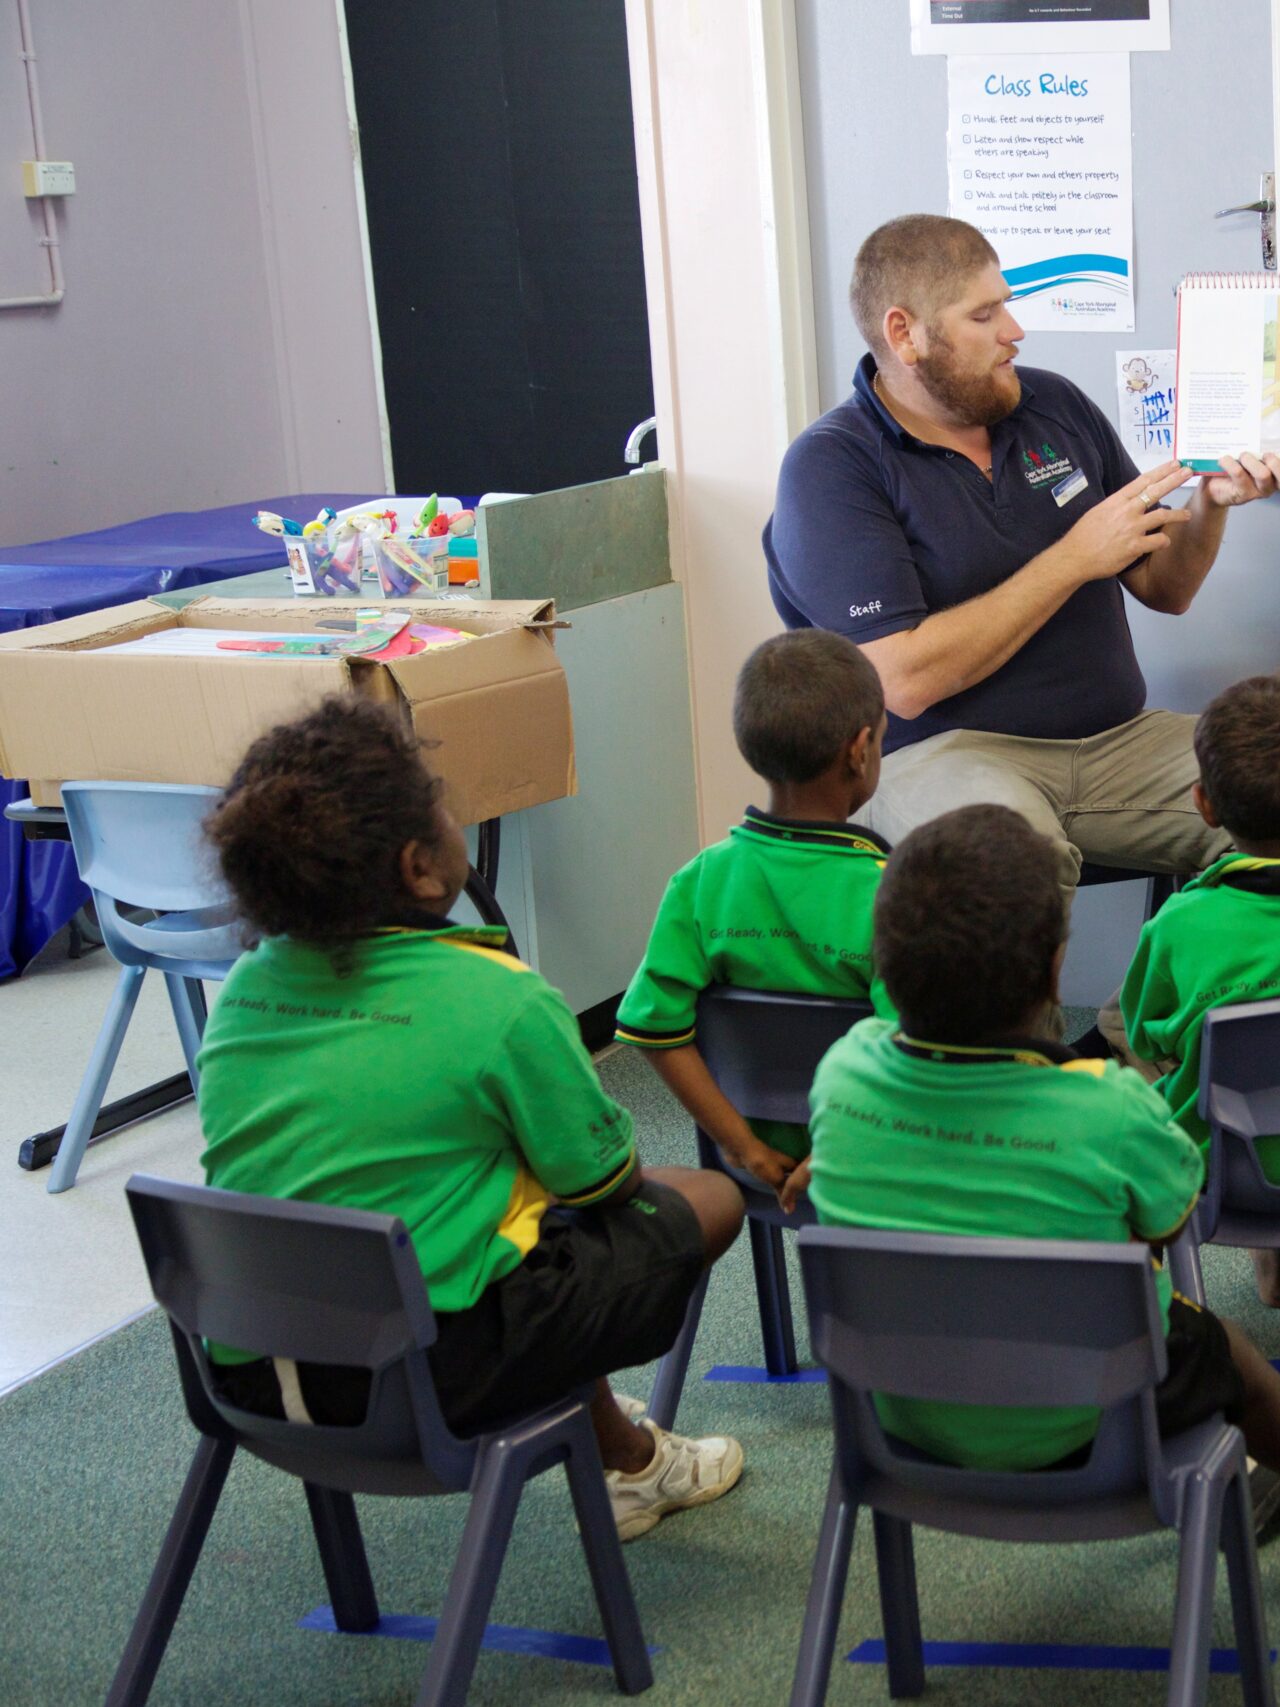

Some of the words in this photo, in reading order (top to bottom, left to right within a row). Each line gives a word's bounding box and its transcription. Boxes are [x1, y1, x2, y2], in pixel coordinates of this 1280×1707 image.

[984, 74, 1031, 97] Class
[1039, 73, 1088, 97] Rules
[1000, 114, 1017, 123] feet
[1019, 115, 1034, 123] and
[1035, 115, 1062, 125] objects
[1064, 115, 1073, 123] to
[1074, 114, 1104, 125] yourself
[974, 134, 997, 143] Listen
[999, 135, 1013, 144] and
[1014, 135, 1032, 144] show
[1033, 135, 1063, 145] respect
[1065, 135, 1084, 144] while
[974, 149, 998, 157] others
[1015, 149, 1049, 159] speaking
[975, 170, 1005, 180] Respect
[1007, 171, 1023, 181] your
[1042, 171, 1056, 179] and
[1058, 171, 1082, 179] others
[1084, 171, 1119, 181] property
[976, 190, 996, 199] Walk
[998, 191, 1013, 199] and
[1014, 190, 1029, 199] talk
[1031, 190, 1057, 201] politely
[1058, 191, 1066, 199] in
[1067, 190, 1082, 200] the
[1083, 190, 1119, 200] classroom
[991, 204, 1018, 212] around
[1019, 203, 1033, 212] the
[1035, 203, 1057, 212] school
[1000, 227, 1009, 236] up
[1020, 226, 1042, 236] speak
[1053, 226, 1074, 235] leave
[1075, 227, 1092, 236] your
[1094, 227, 1112, 235] seat
[849, 600, 882, 617] Staff
[1196, 990, 1217, 1002] Get
[276, 1003, 308, 1017] Work
[311, 1007, 345, 1021] hard.
[350, 1009, 366, 1021] Be
[891, 1117, 932, 1139] Work
[983, 1134, 1006, 1148] Be
